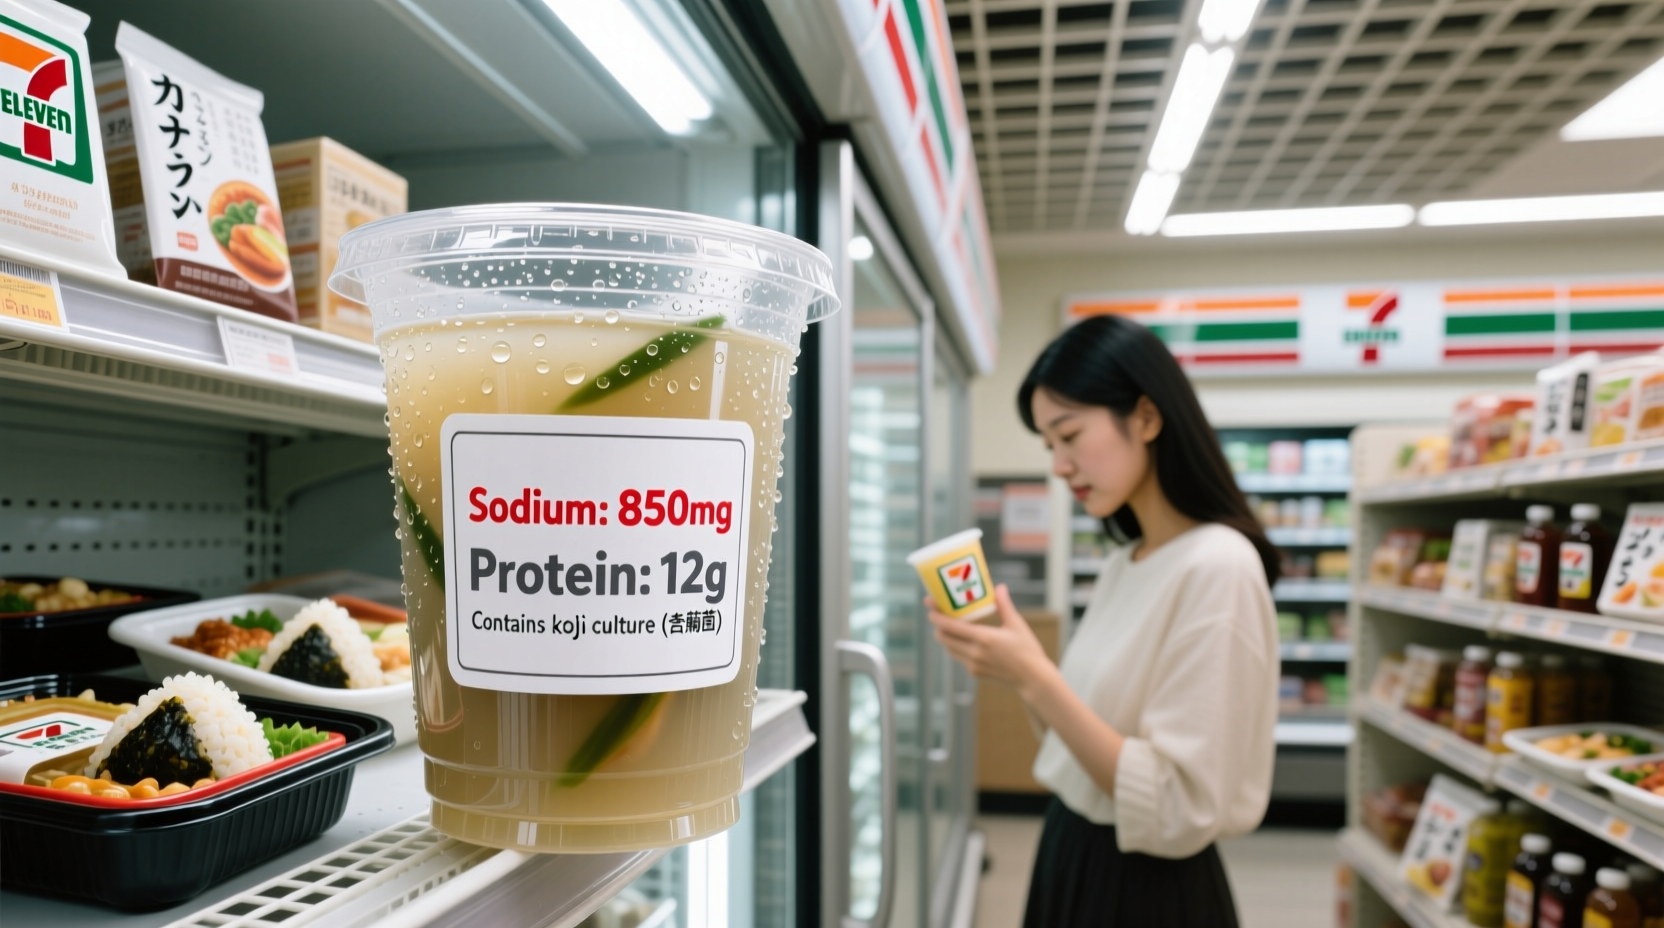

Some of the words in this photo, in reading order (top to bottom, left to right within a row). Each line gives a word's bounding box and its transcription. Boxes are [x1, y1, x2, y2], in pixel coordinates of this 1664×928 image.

[468, 486, 609, 527] Sodium:
[617, 488, 733, 535] 850mg
[470, 547, 652, 597] Protein:
[660, 550, 728, 604] 12g
[471, 610, 546, 635] Contains
[551, 613, 587, 641] koji
[591, 615, 656, 635] culture
